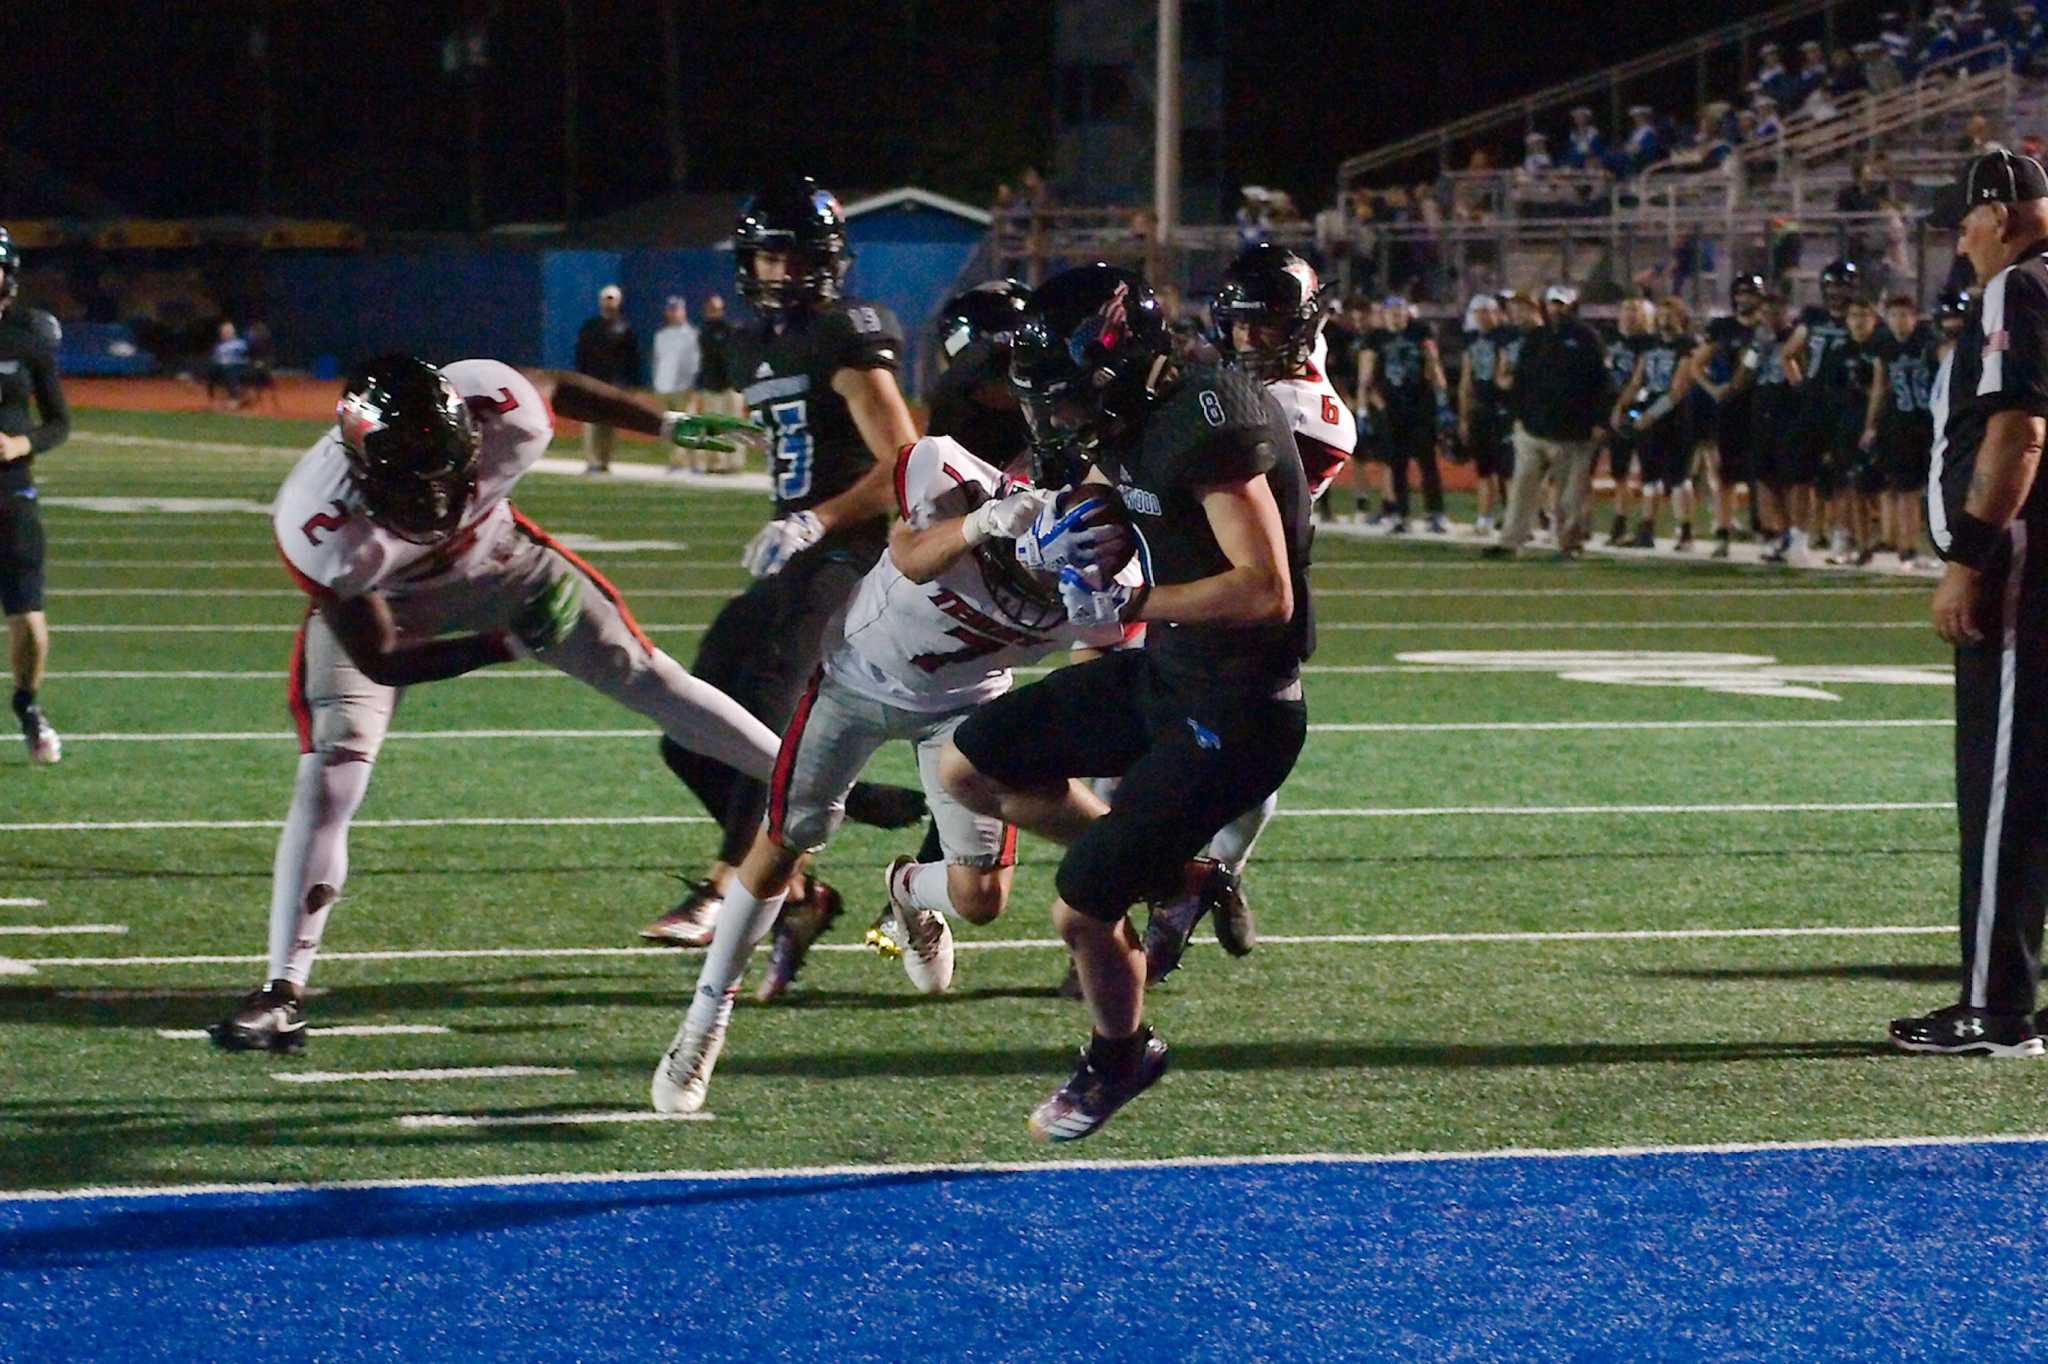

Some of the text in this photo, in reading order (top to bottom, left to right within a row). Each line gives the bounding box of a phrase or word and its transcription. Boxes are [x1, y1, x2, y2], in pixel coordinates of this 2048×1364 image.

[1199, 390, 1226, 427] 8
[1321, 394, 1341, 426] 6
[301, 499, 351, 546] 2
